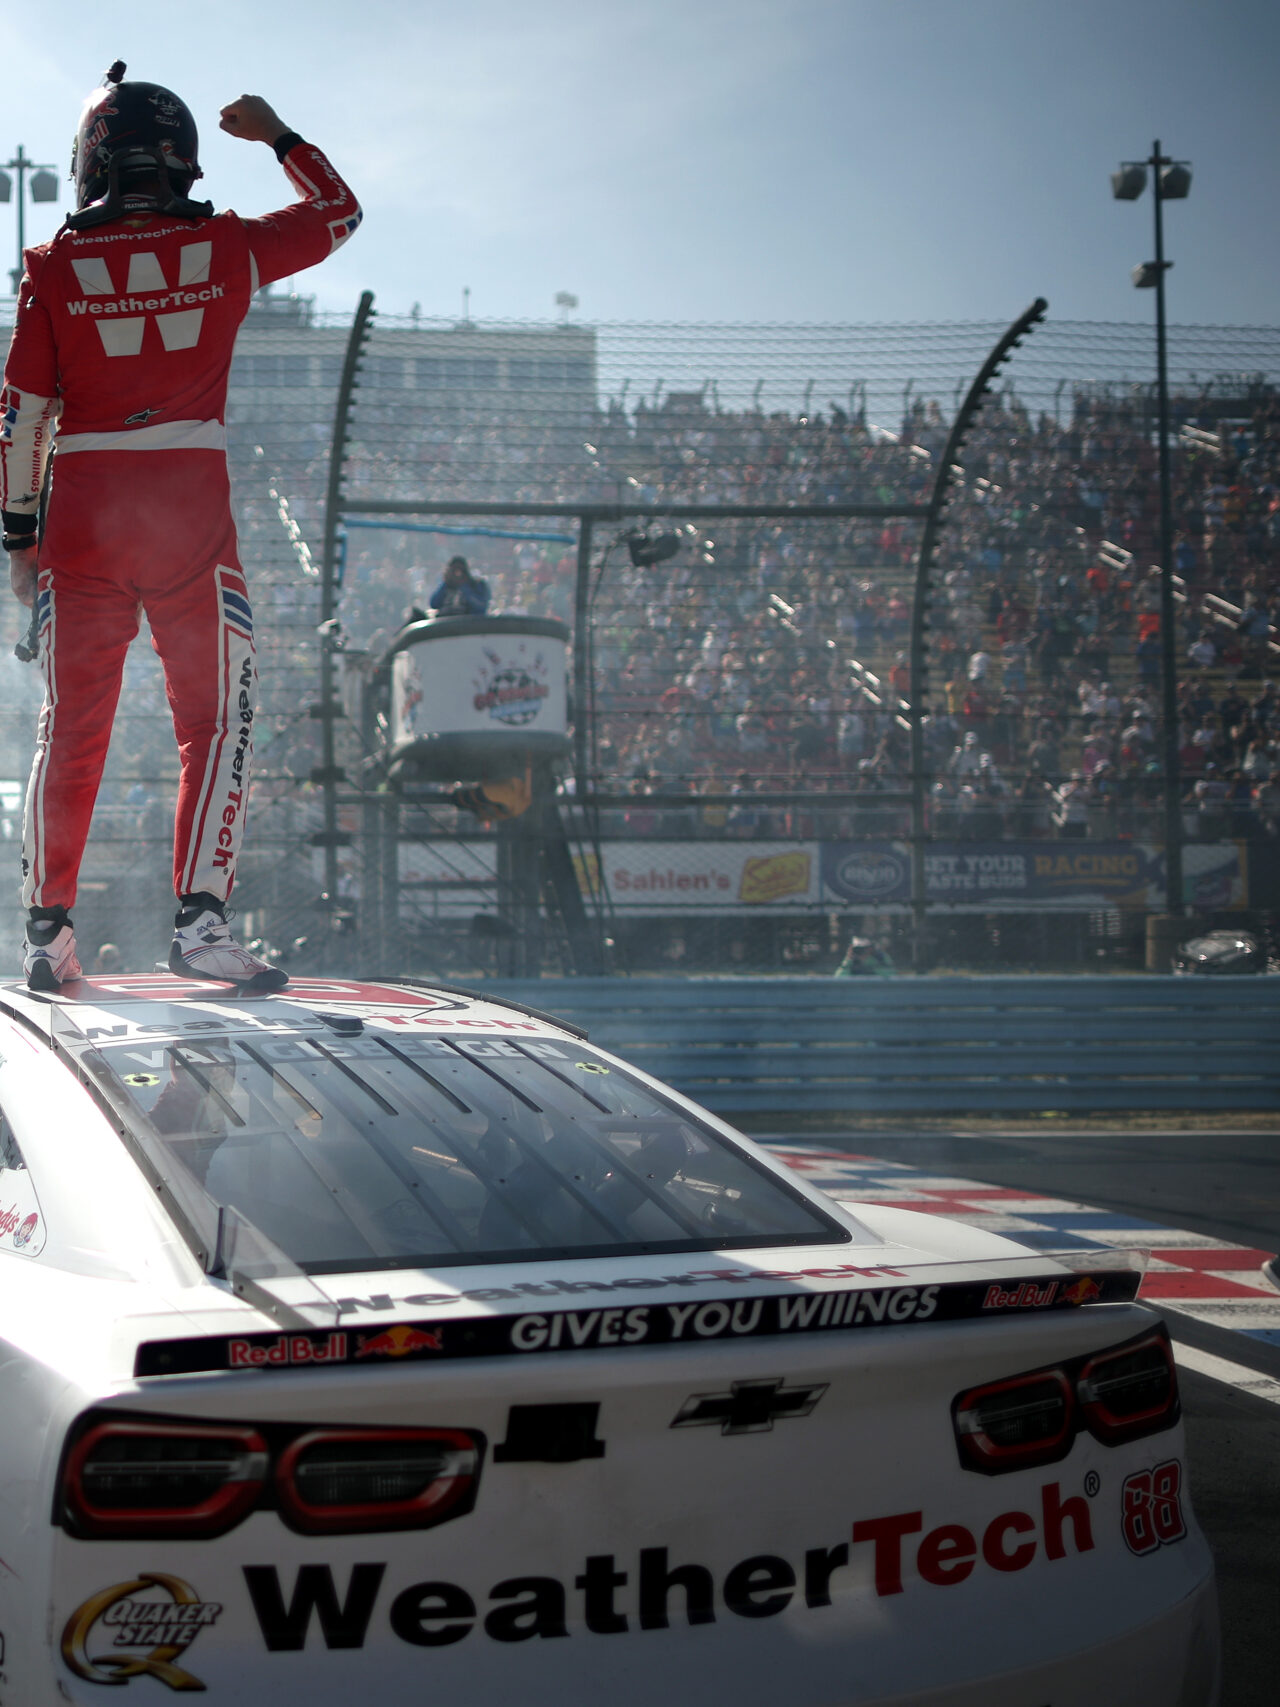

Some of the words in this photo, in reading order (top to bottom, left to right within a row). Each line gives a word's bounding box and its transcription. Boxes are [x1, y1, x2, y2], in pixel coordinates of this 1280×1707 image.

[964, 855, 1026, 873] YOUR
[1034, 854, 1138, 876] RACING
[614, 869, 730, 891] Sahlen's
[510, 1307, 650, 1350] GIVES
[670, 1300, 763, 1340] YOU
[1122, 1458, 1186, 1557] 88
[103, 1597, 224, 1626] QUAKER
[113, 1623, 200, 1647] STATE
